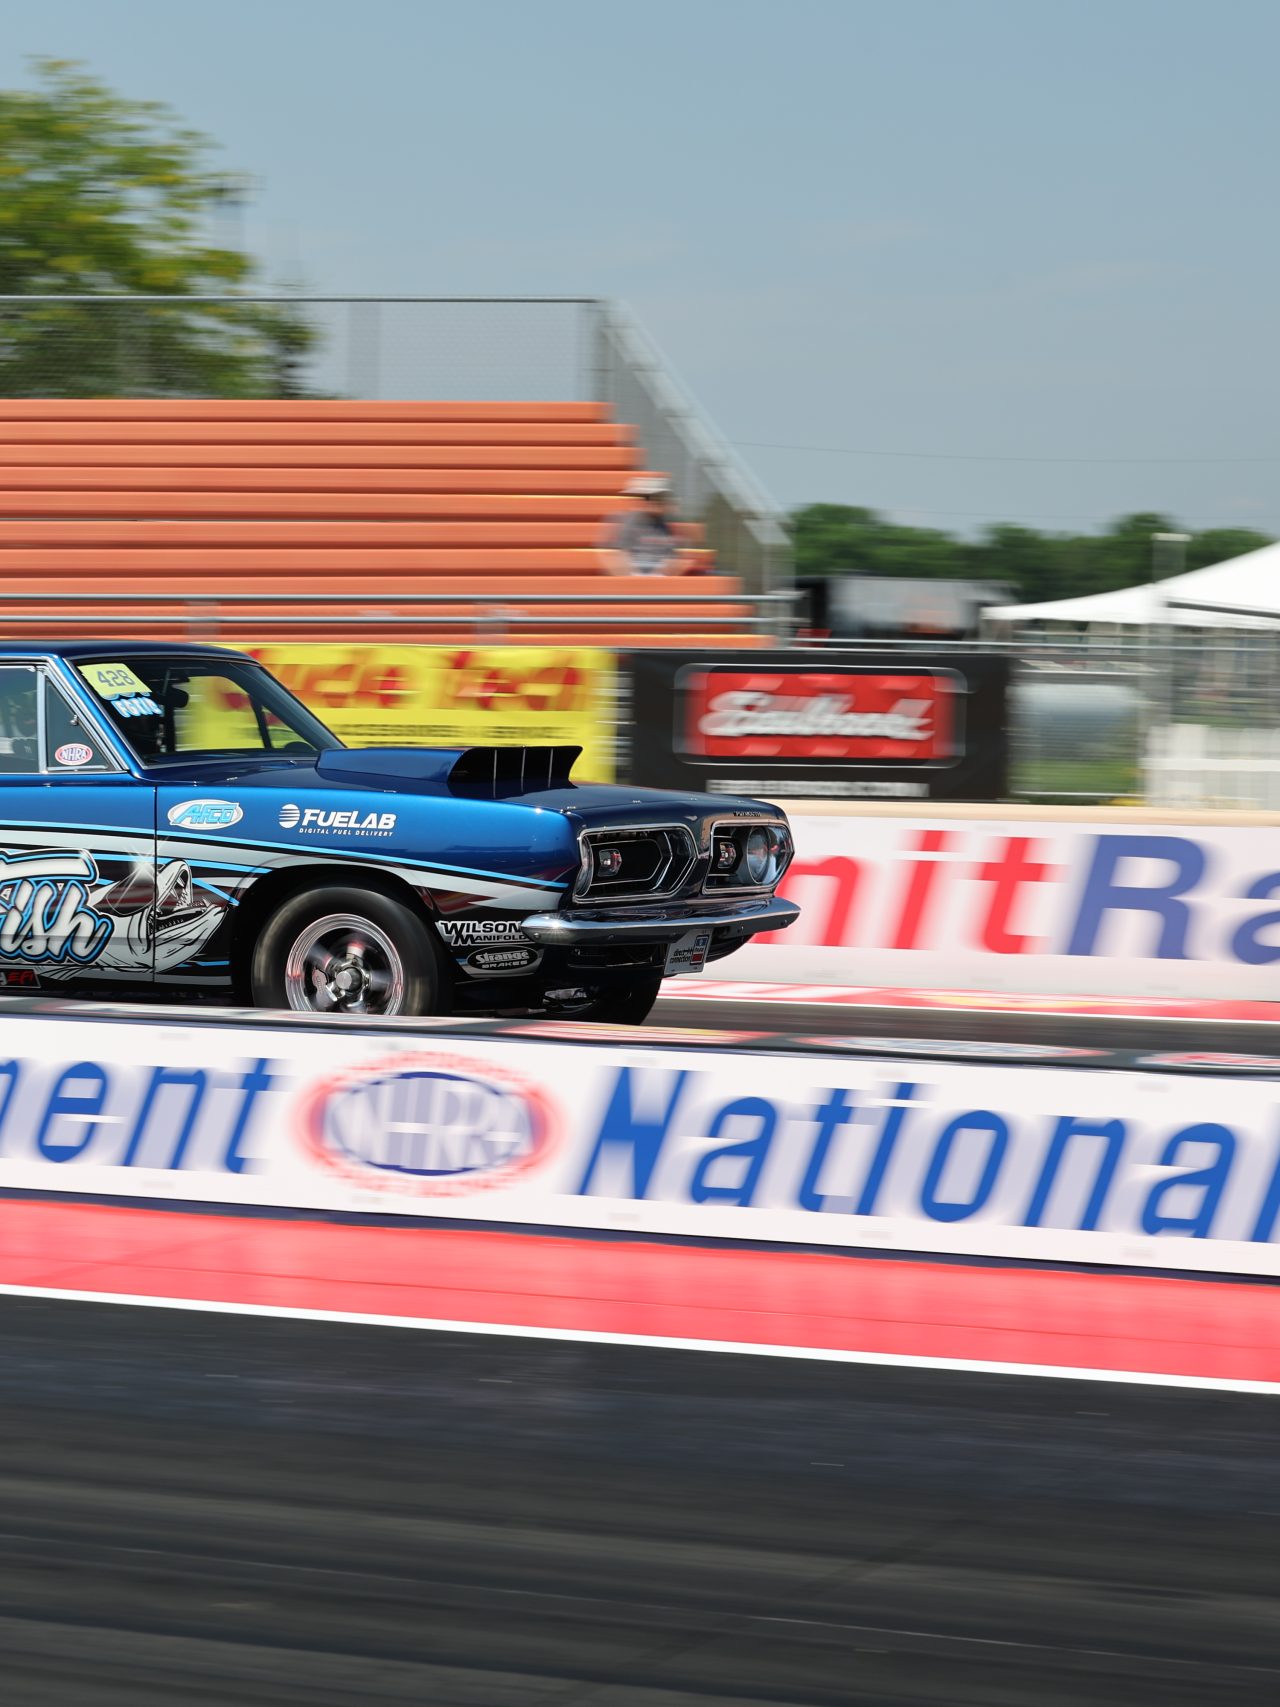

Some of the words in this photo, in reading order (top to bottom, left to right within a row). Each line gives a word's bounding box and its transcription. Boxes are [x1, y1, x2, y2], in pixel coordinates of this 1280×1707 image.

[97, 669, 135, 687] 428
[61, 747, 88, 761] NHRA
[440, 922, 522, 935] WILSON
[476, 950, 530, 964] Strange
[482, 960, 528, 968] BRAKES
